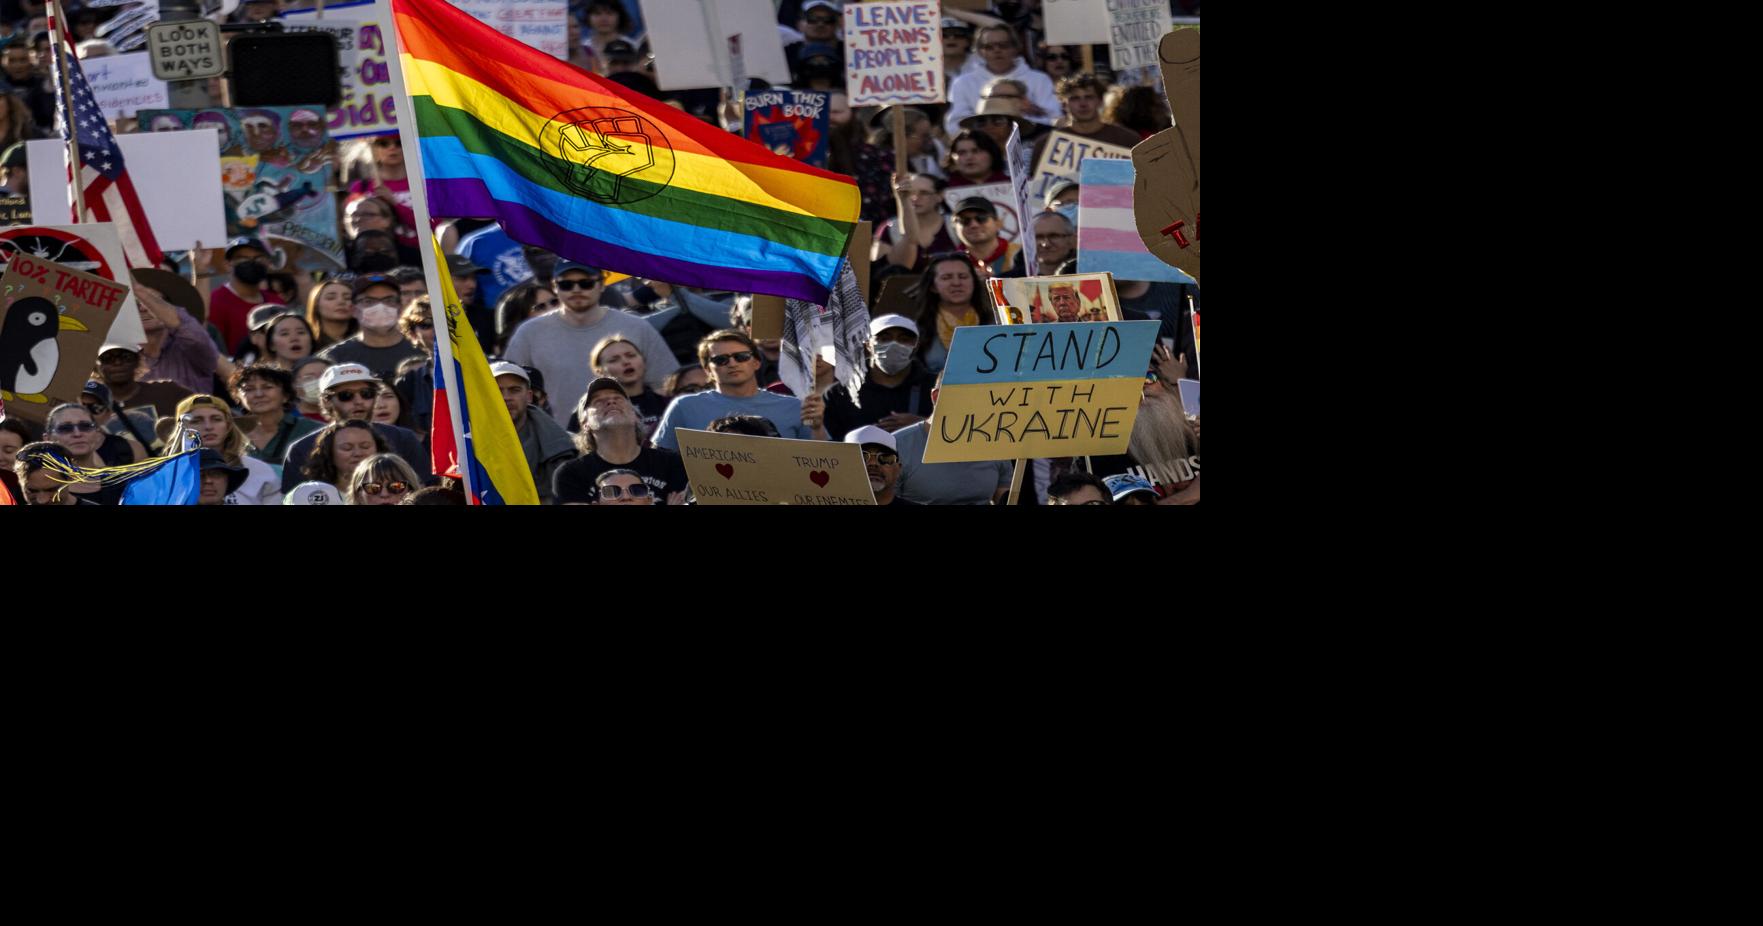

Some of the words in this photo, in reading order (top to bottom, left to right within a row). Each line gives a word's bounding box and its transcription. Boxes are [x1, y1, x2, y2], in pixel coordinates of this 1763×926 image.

[856, 5, 930, 26] LEAVE
[158, 27, 208, 43] LOOK
[859, 27, 931, 46] TRANS
[160, 43, 211, 58] BOTH
[854, 48, 923, 69] PEOPLE
[160, 57, 214, 72] WAYS
[860, 70, 936, 95] ALONE!
[745, 92, 784, 111] BURN
[790, 91, 827, 107] THIS
[783, 104, 824, 120] BOOK
[1050, 137, 1091, 172] EAT
[12, 256, 49, 284] 10%
[54, 270, 123, 311] TARIFF
[976, 326, 1121, 374] STAND
[989, 383, 1095, 406] WITH
[941, 406, 1128, 444] UKRAINE
[686, 445, 757, 464] AMERICANS
[792, 455, 840, 470] TRUMP
[698, 483, 722, 499] OUR
[725, 487, 769, 503] ALLIES
